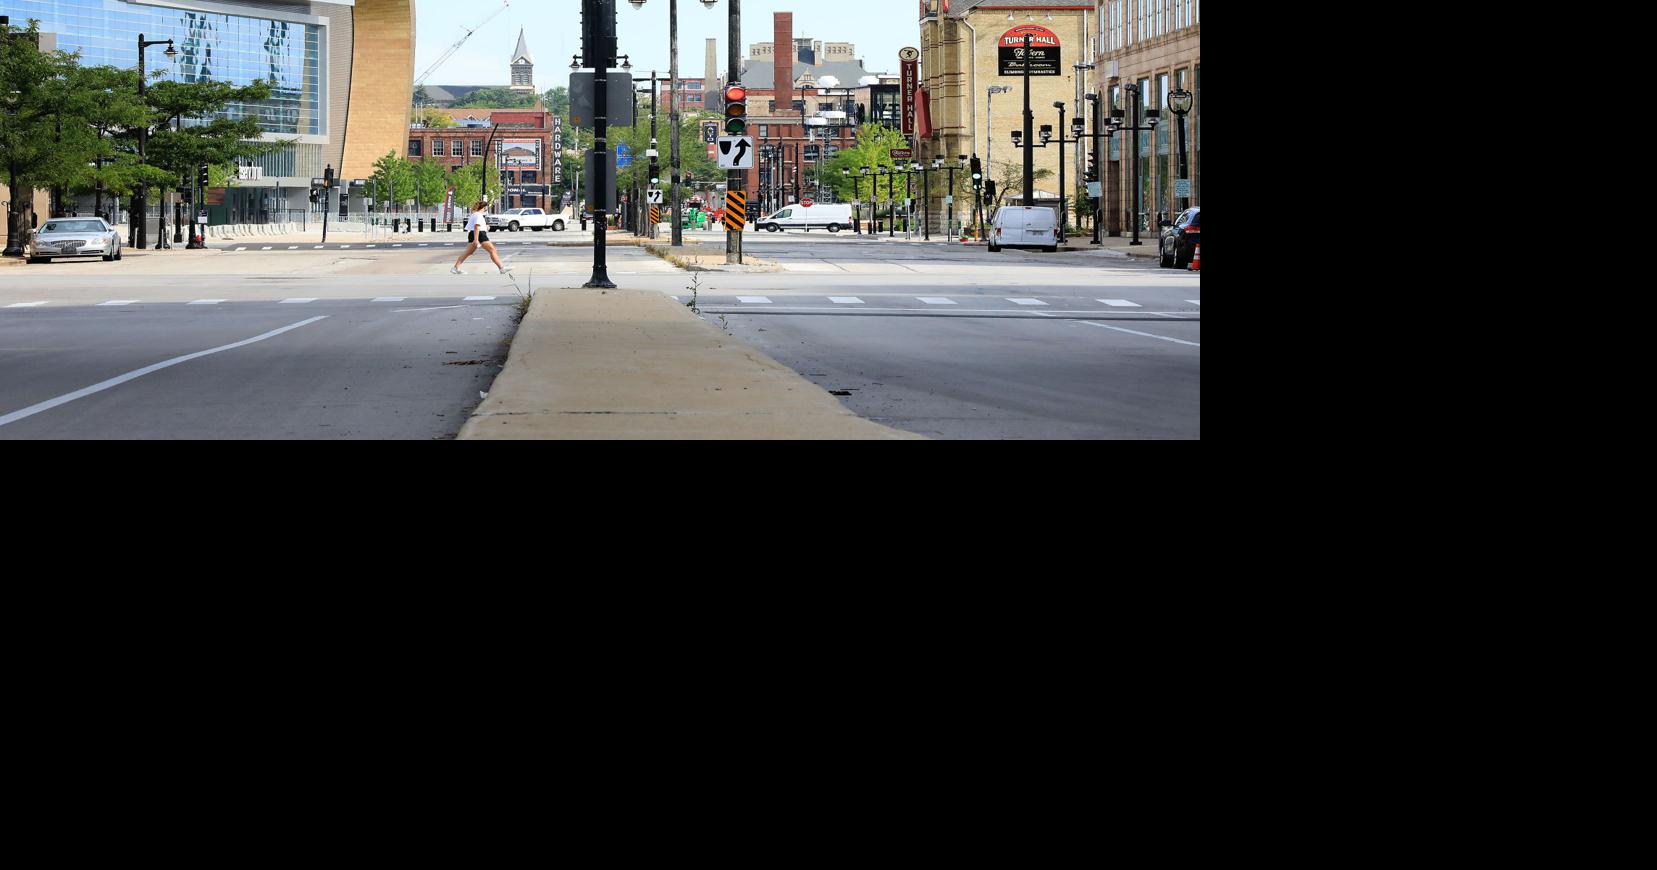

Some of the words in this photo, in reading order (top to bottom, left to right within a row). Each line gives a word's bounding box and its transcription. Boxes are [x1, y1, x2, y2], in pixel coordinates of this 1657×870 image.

[1004, 36, 1034, 45] TURNR
[1036, 36, 1056, 45] HALL
[554, 118, 562, 183] HARDWARE
